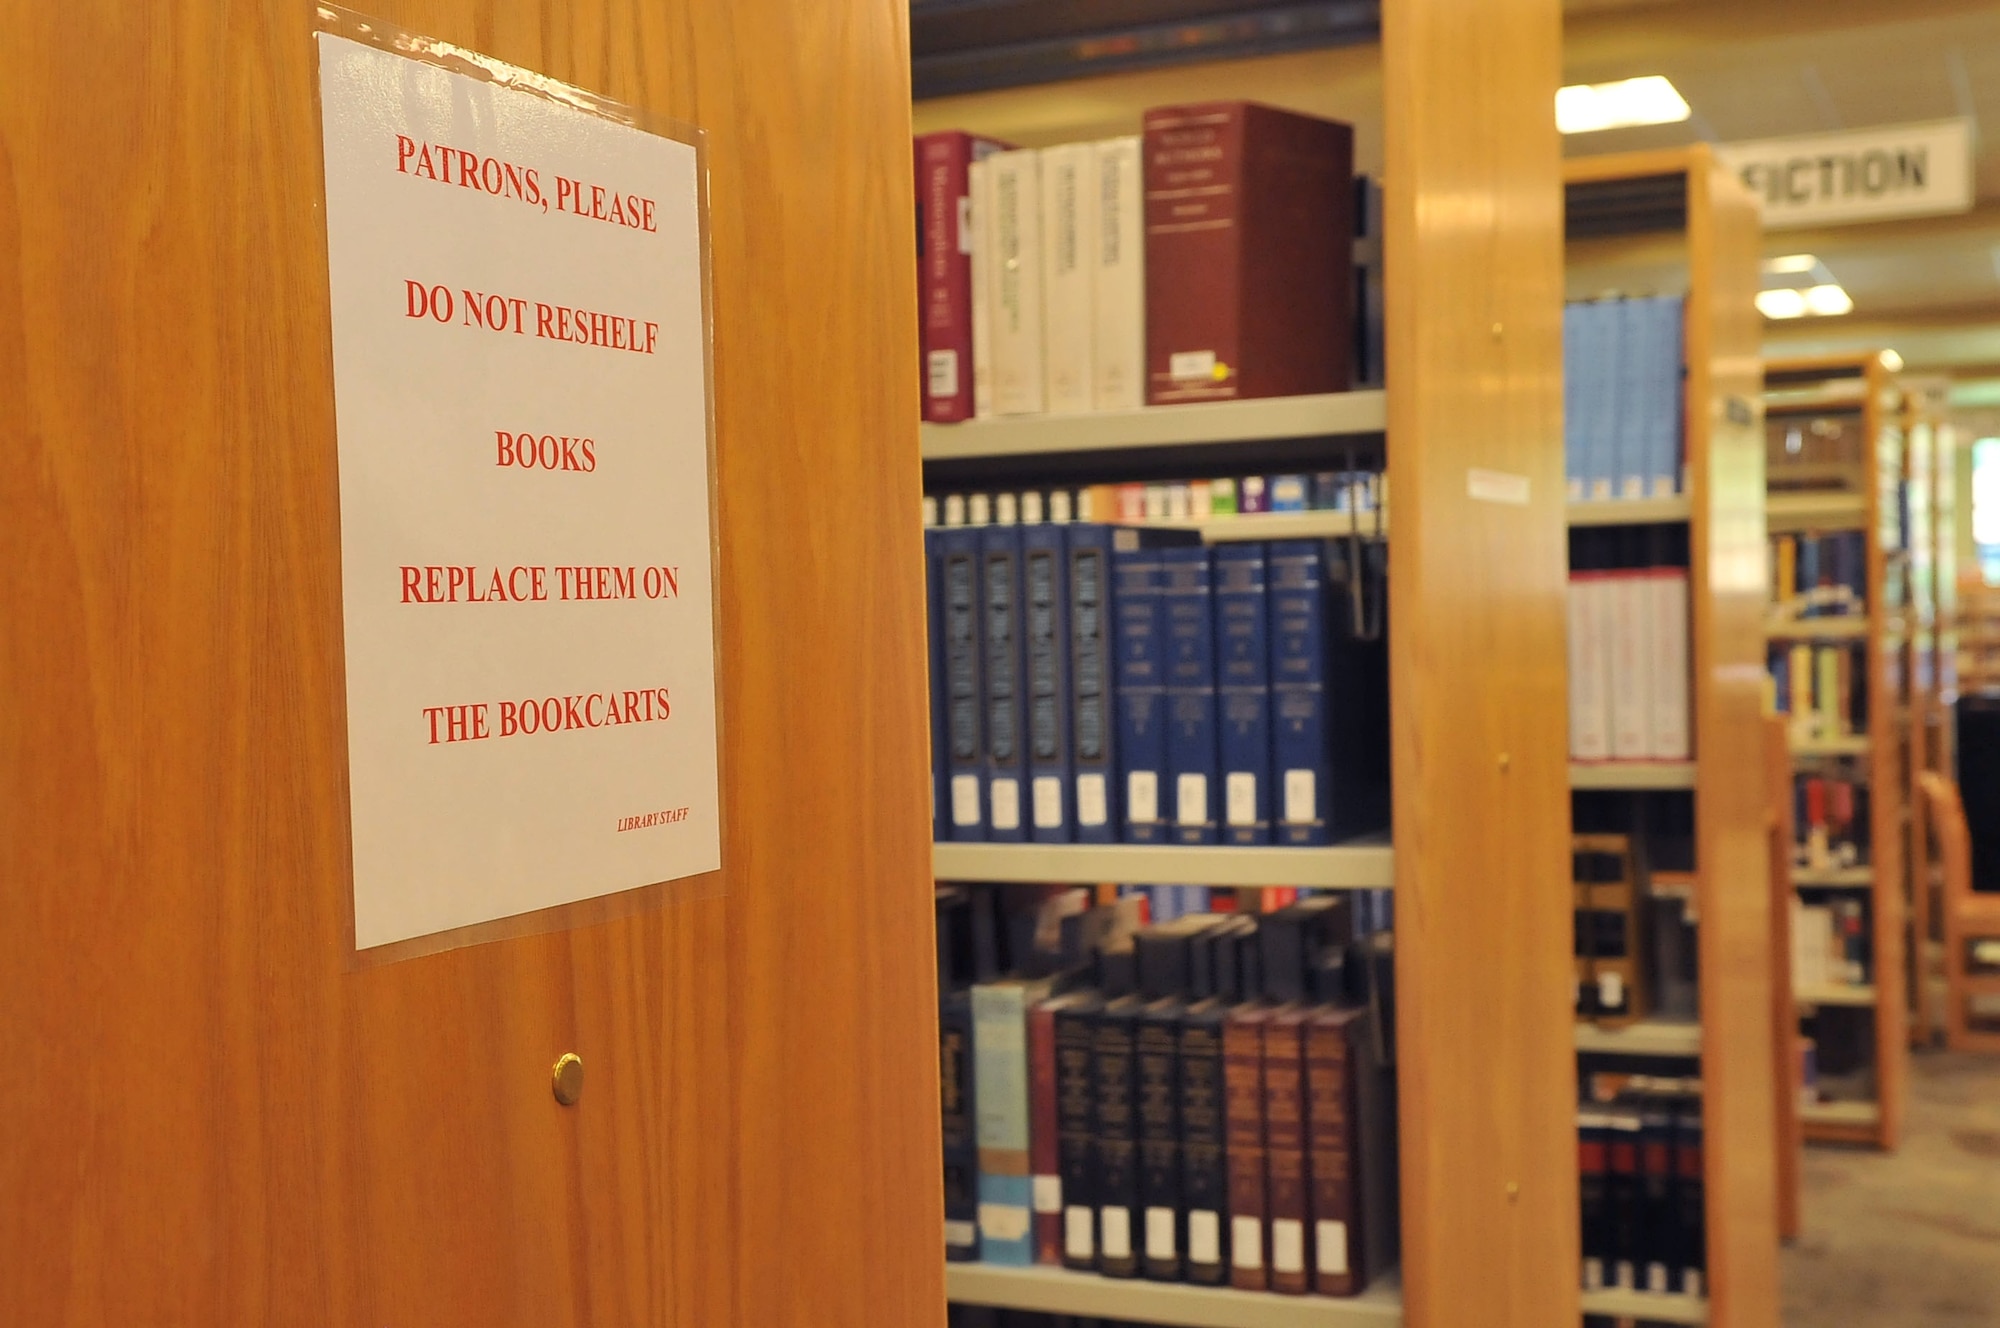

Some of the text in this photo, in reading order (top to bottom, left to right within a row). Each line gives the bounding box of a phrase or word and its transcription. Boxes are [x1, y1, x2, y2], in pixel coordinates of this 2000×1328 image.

[395, 133, 659, 234] PATRONS, PLEASE
[404, 278, 660, 356] DO NOT RESHELF
[495, 430, 598, 474] BOOKS
[399, 564, 680, 605] REPLACE THEM ON
[421, 686, 672, 746] THE BOOKCARTS
[617, 806, 689, 833] LIBRARY STAFF
